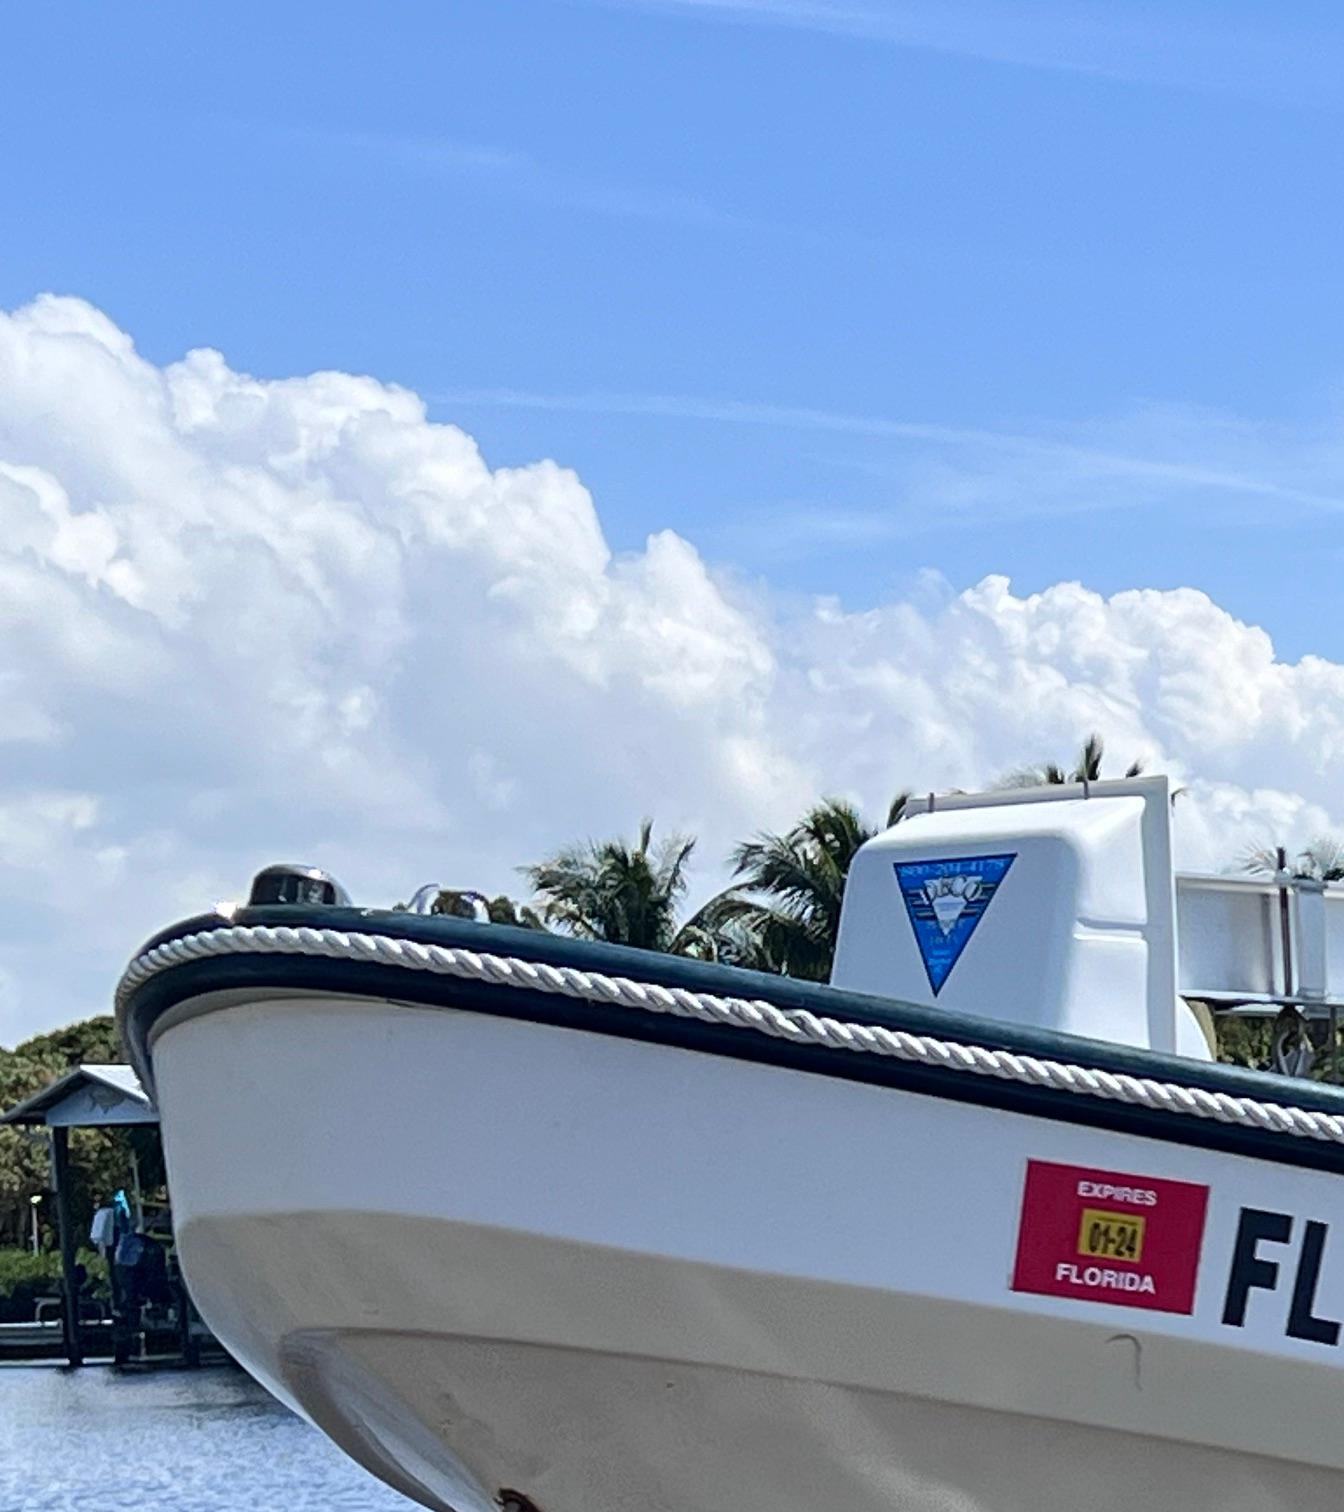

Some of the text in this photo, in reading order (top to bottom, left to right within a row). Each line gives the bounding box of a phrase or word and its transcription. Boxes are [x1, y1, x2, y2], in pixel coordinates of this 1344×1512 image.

[1077, 1181, 1157, 1206] EXPIRES
[1089, 1222, 1138, 1258] 01-24
[1056, 1263, 1156, 1294] FLORIDA
[1222, 1206, 1342, 1346] FL
